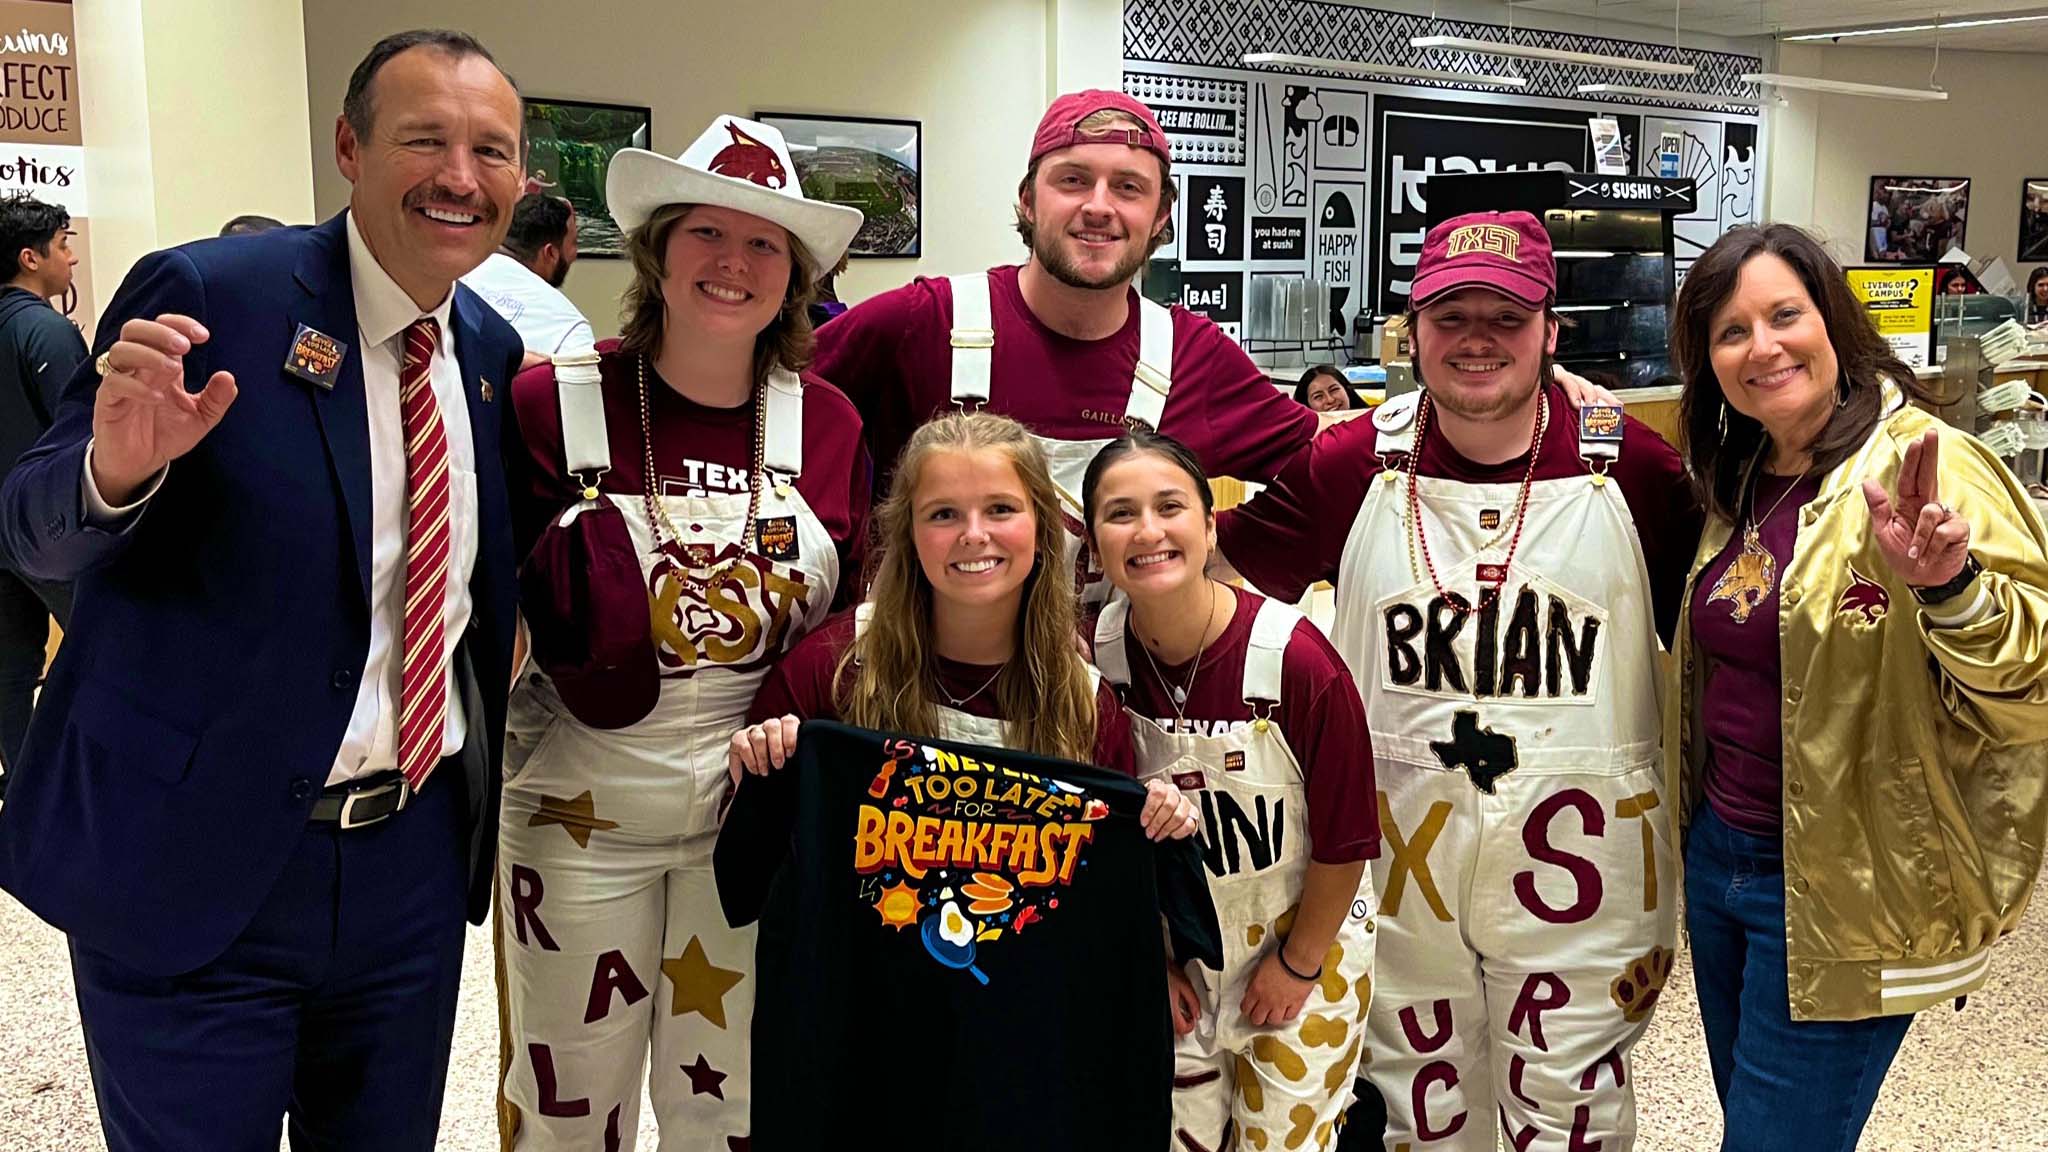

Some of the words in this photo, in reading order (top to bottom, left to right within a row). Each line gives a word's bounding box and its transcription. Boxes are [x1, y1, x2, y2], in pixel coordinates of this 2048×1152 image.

[0, 29, 68, 56] uing
[0, 62, 71, 101] FECT
[1160, 110, 1177, 128] SEE
[1178, 111, 1194, 128] ME
[1662, 136, 1680, 153] OPEN
[1612, 182, 1651, 200] SUSHI
[1203, 184, 1228, 255] 寿司
[1255, 228, 1270, 239] you
[1271, 226, 1287, 237] had
[1288, 229, 1301, 238] me
[1446, 223, 1522, 264] TXST
[1262, 240, 1272, 250] at
[1273, 240, 1293, 250] sushi
[1319, 234, 1358, 256] HAPPY
[1324, 260, 1350, 283] FISH
[1862, 281, 1893, 289] LIVING
[1868, 290, 1904, 298] CAMPUS
[1384, 583, 1600, 699] BRIAN
[905, 775, 977, 804] TOO
[984, 778, 1064, 817] LATE
[954, 800, 996, 817] FOR
[854, 804, 1094, 888] BREAKFAST
